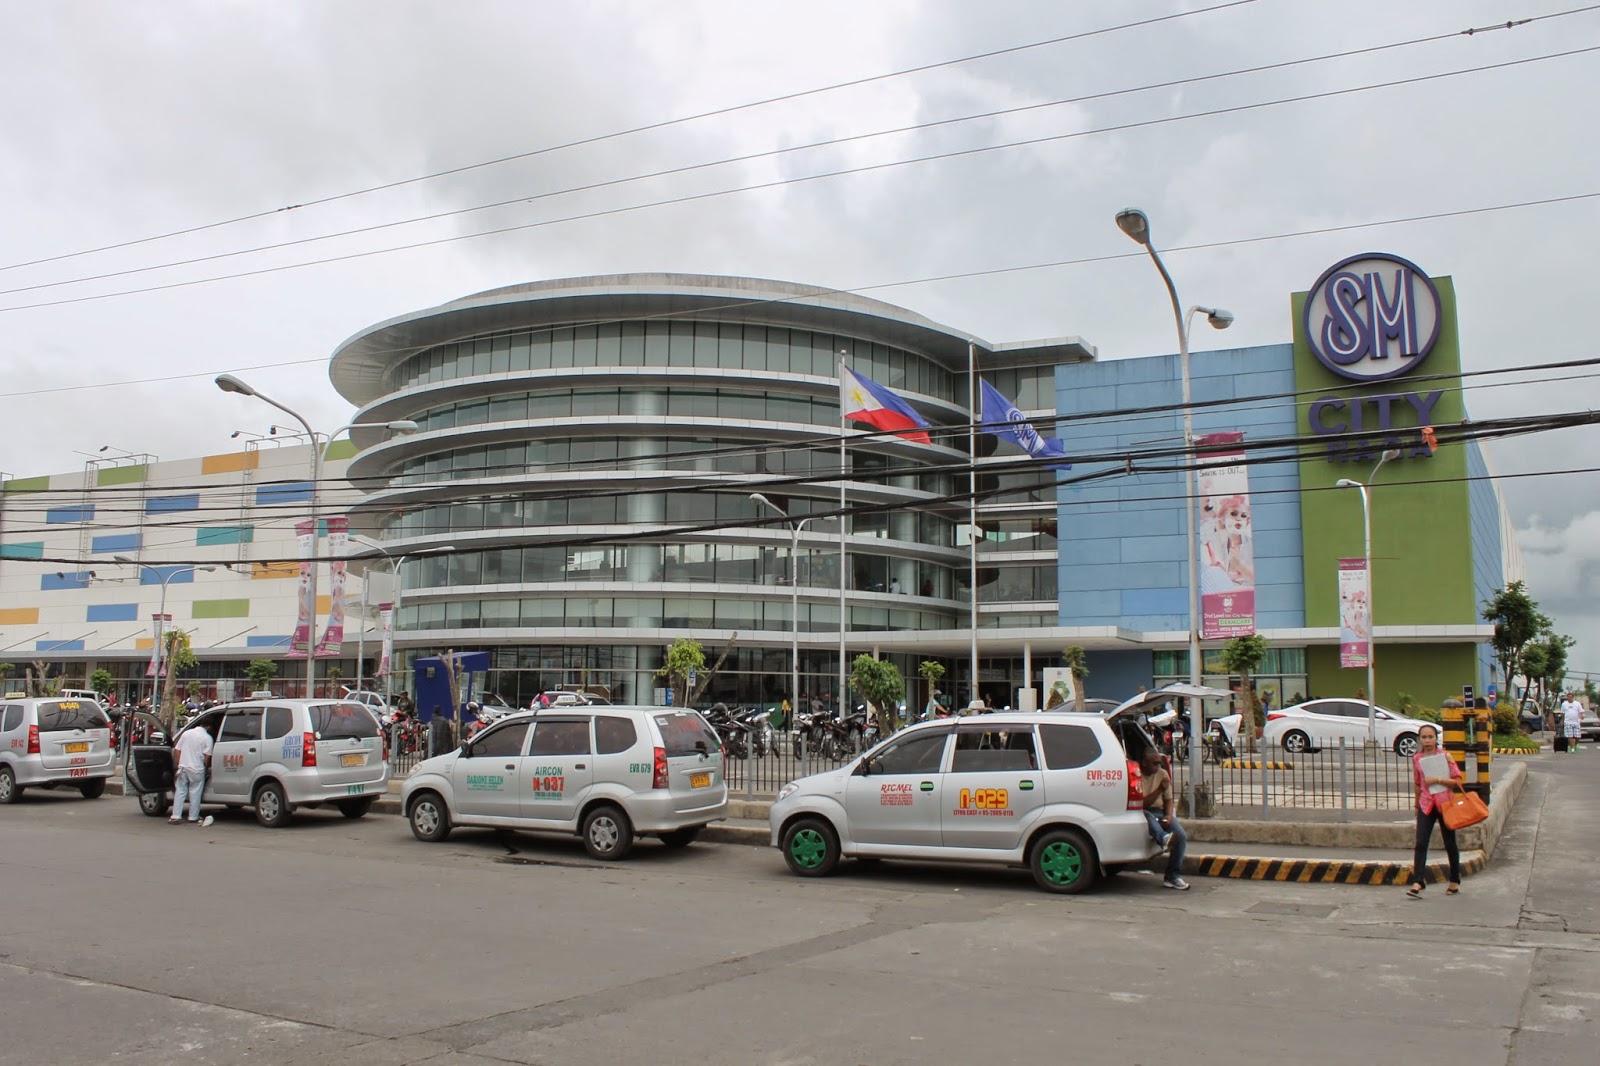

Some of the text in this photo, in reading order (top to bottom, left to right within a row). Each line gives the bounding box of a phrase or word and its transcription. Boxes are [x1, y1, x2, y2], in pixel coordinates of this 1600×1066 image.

[1321, 269, 1419, 365] SM
[1309, 391, 1443, 436] CITY
[69, 768, 88, 777] TAXI
[535, 767, 562, 776] AIRCON
[629, 763, 640, 773] EVR
[1087, 770, 1122, 780] EVR-629
[533, 777, 564, 791] N-037
[881, 784, 912, 793] RICMEL
